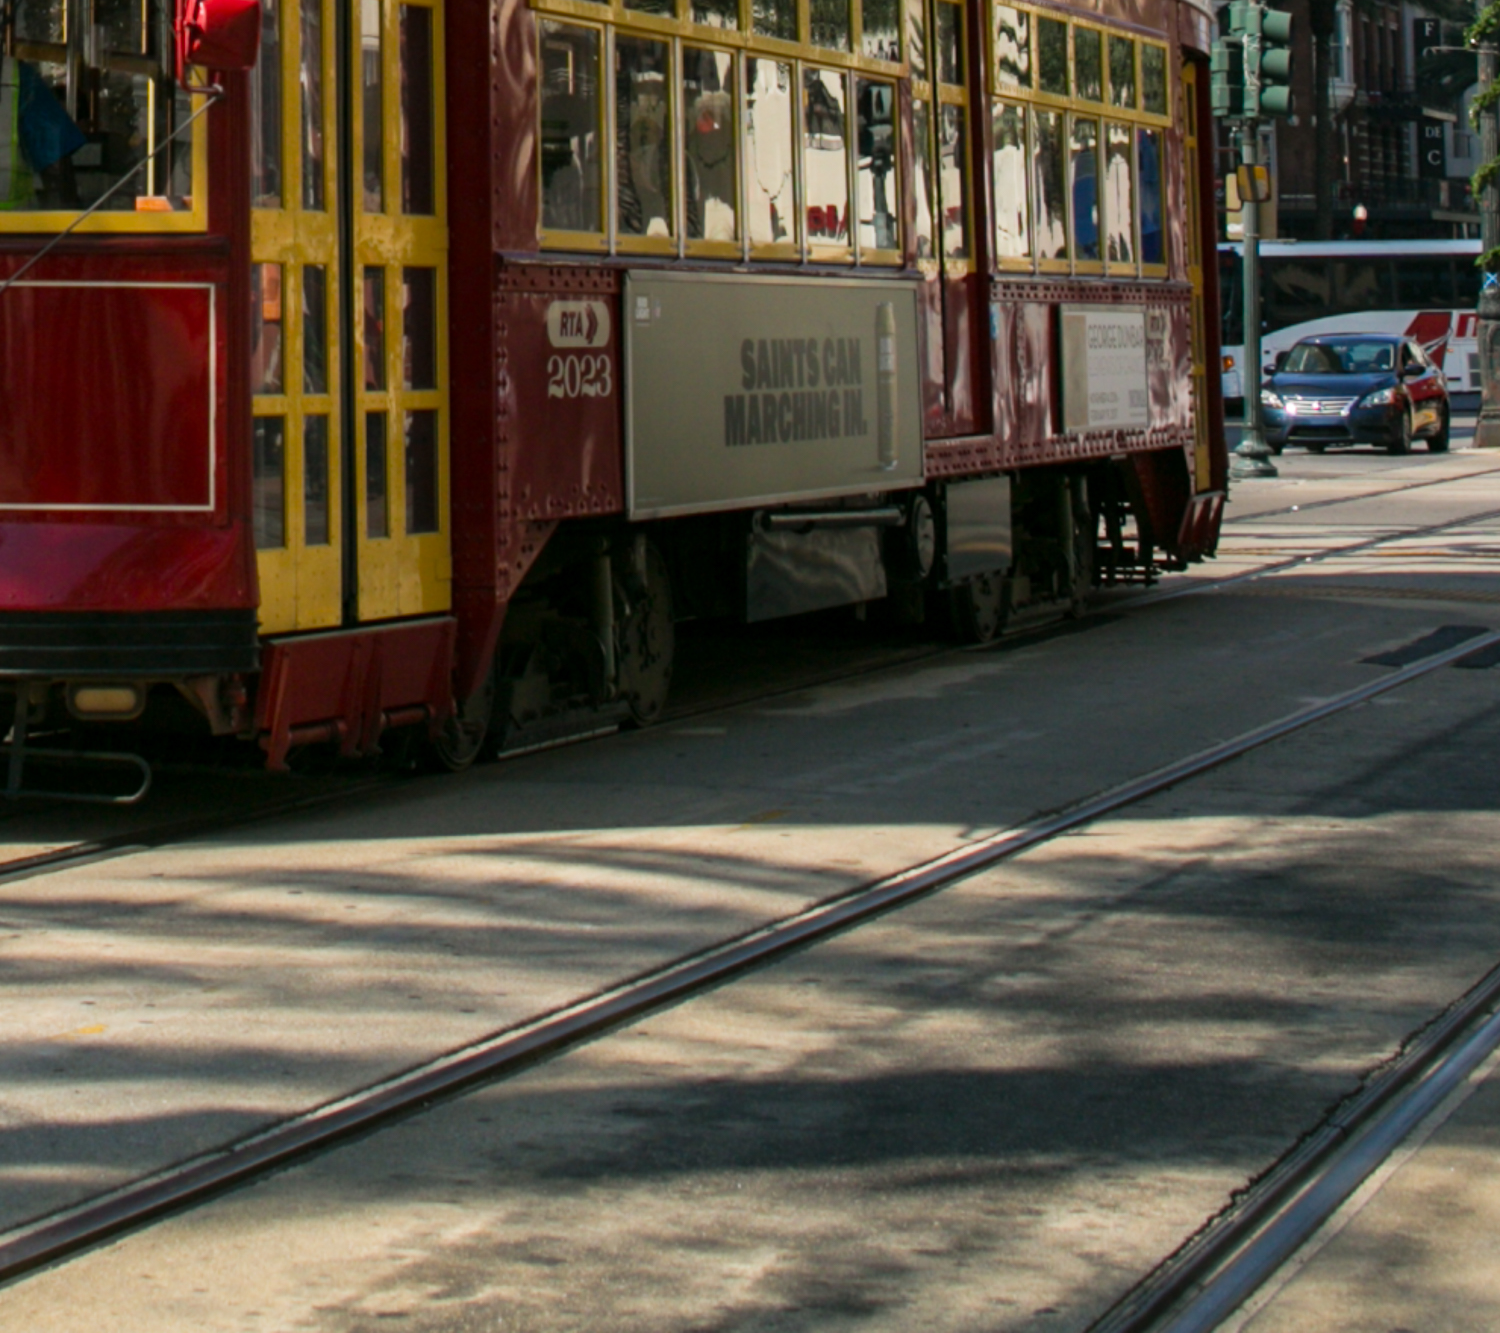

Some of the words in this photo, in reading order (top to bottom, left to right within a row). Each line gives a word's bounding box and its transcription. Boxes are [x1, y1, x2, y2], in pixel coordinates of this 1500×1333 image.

[560, 311, 584, 337] RTA
[546, 354, 613, 399] 2023
[740, 338, 819, 391] SAINTS
[822, 337, 862, 386] CAN
[724, 390, 842, 447] MARCHING
[843, 387, 868, 437] IN.
